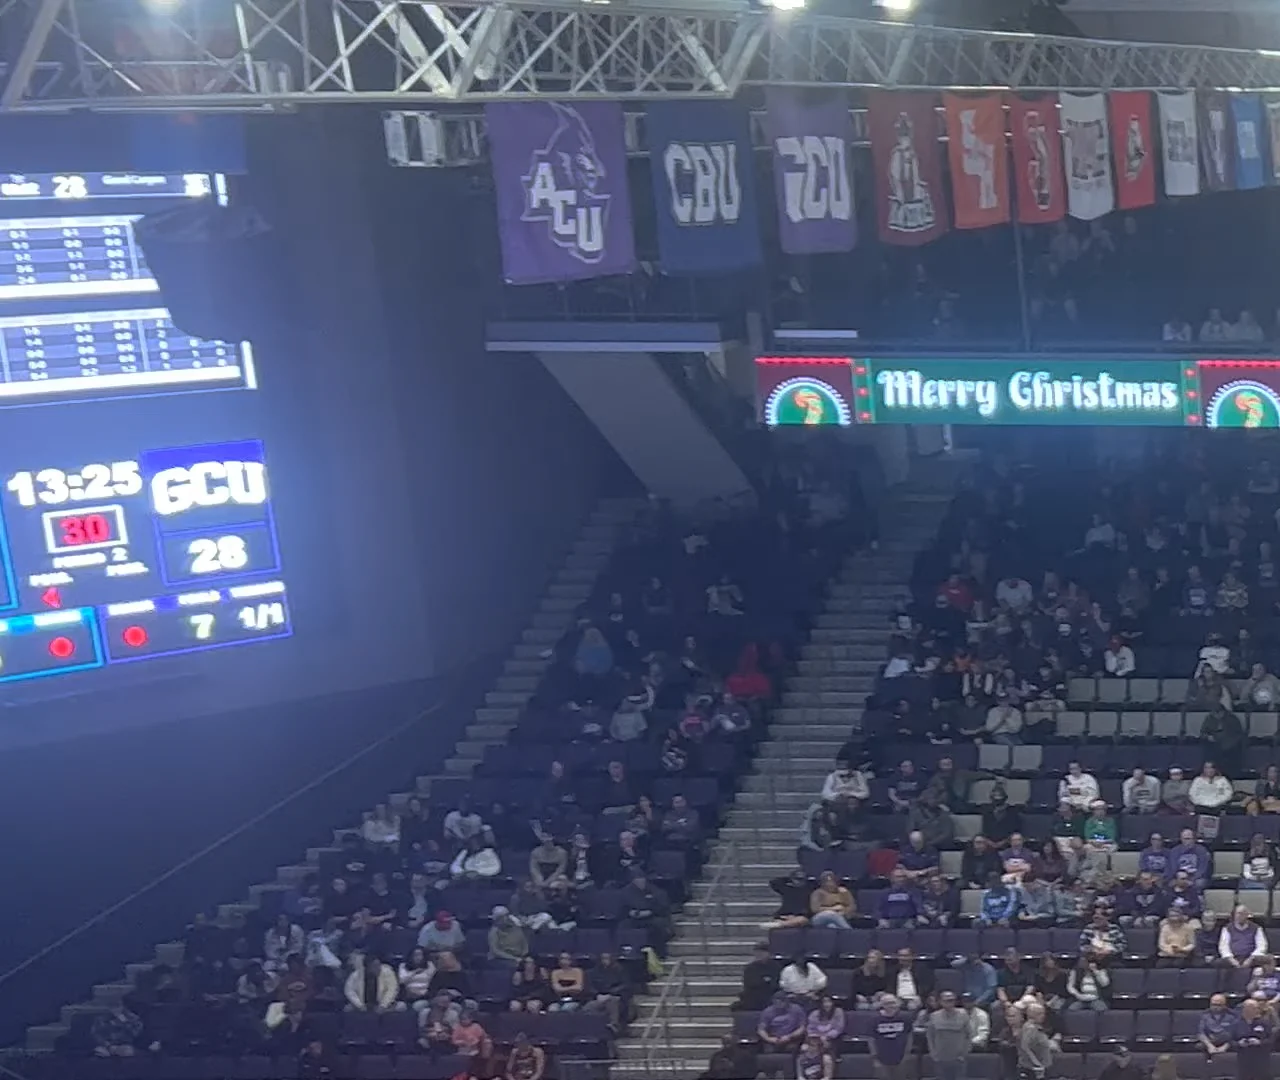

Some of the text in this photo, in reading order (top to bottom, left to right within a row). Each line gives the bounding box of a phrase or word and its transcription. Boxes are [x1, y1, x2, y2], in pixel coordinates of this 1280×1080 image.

[664, 142, 741, 224] CBU
[530, 162, 604, 252] ACU
[877, 370, 1178, 415] Merry Christmas
[7, 461, 144, 506] 13:25
[151, 461, 267, 515] GCU
[60, 514, 110, 545] 30
[187, 535, 249, 574] 28
[190, 614, 215, 639] 7
[238, 603, 284, 630] 1/1
